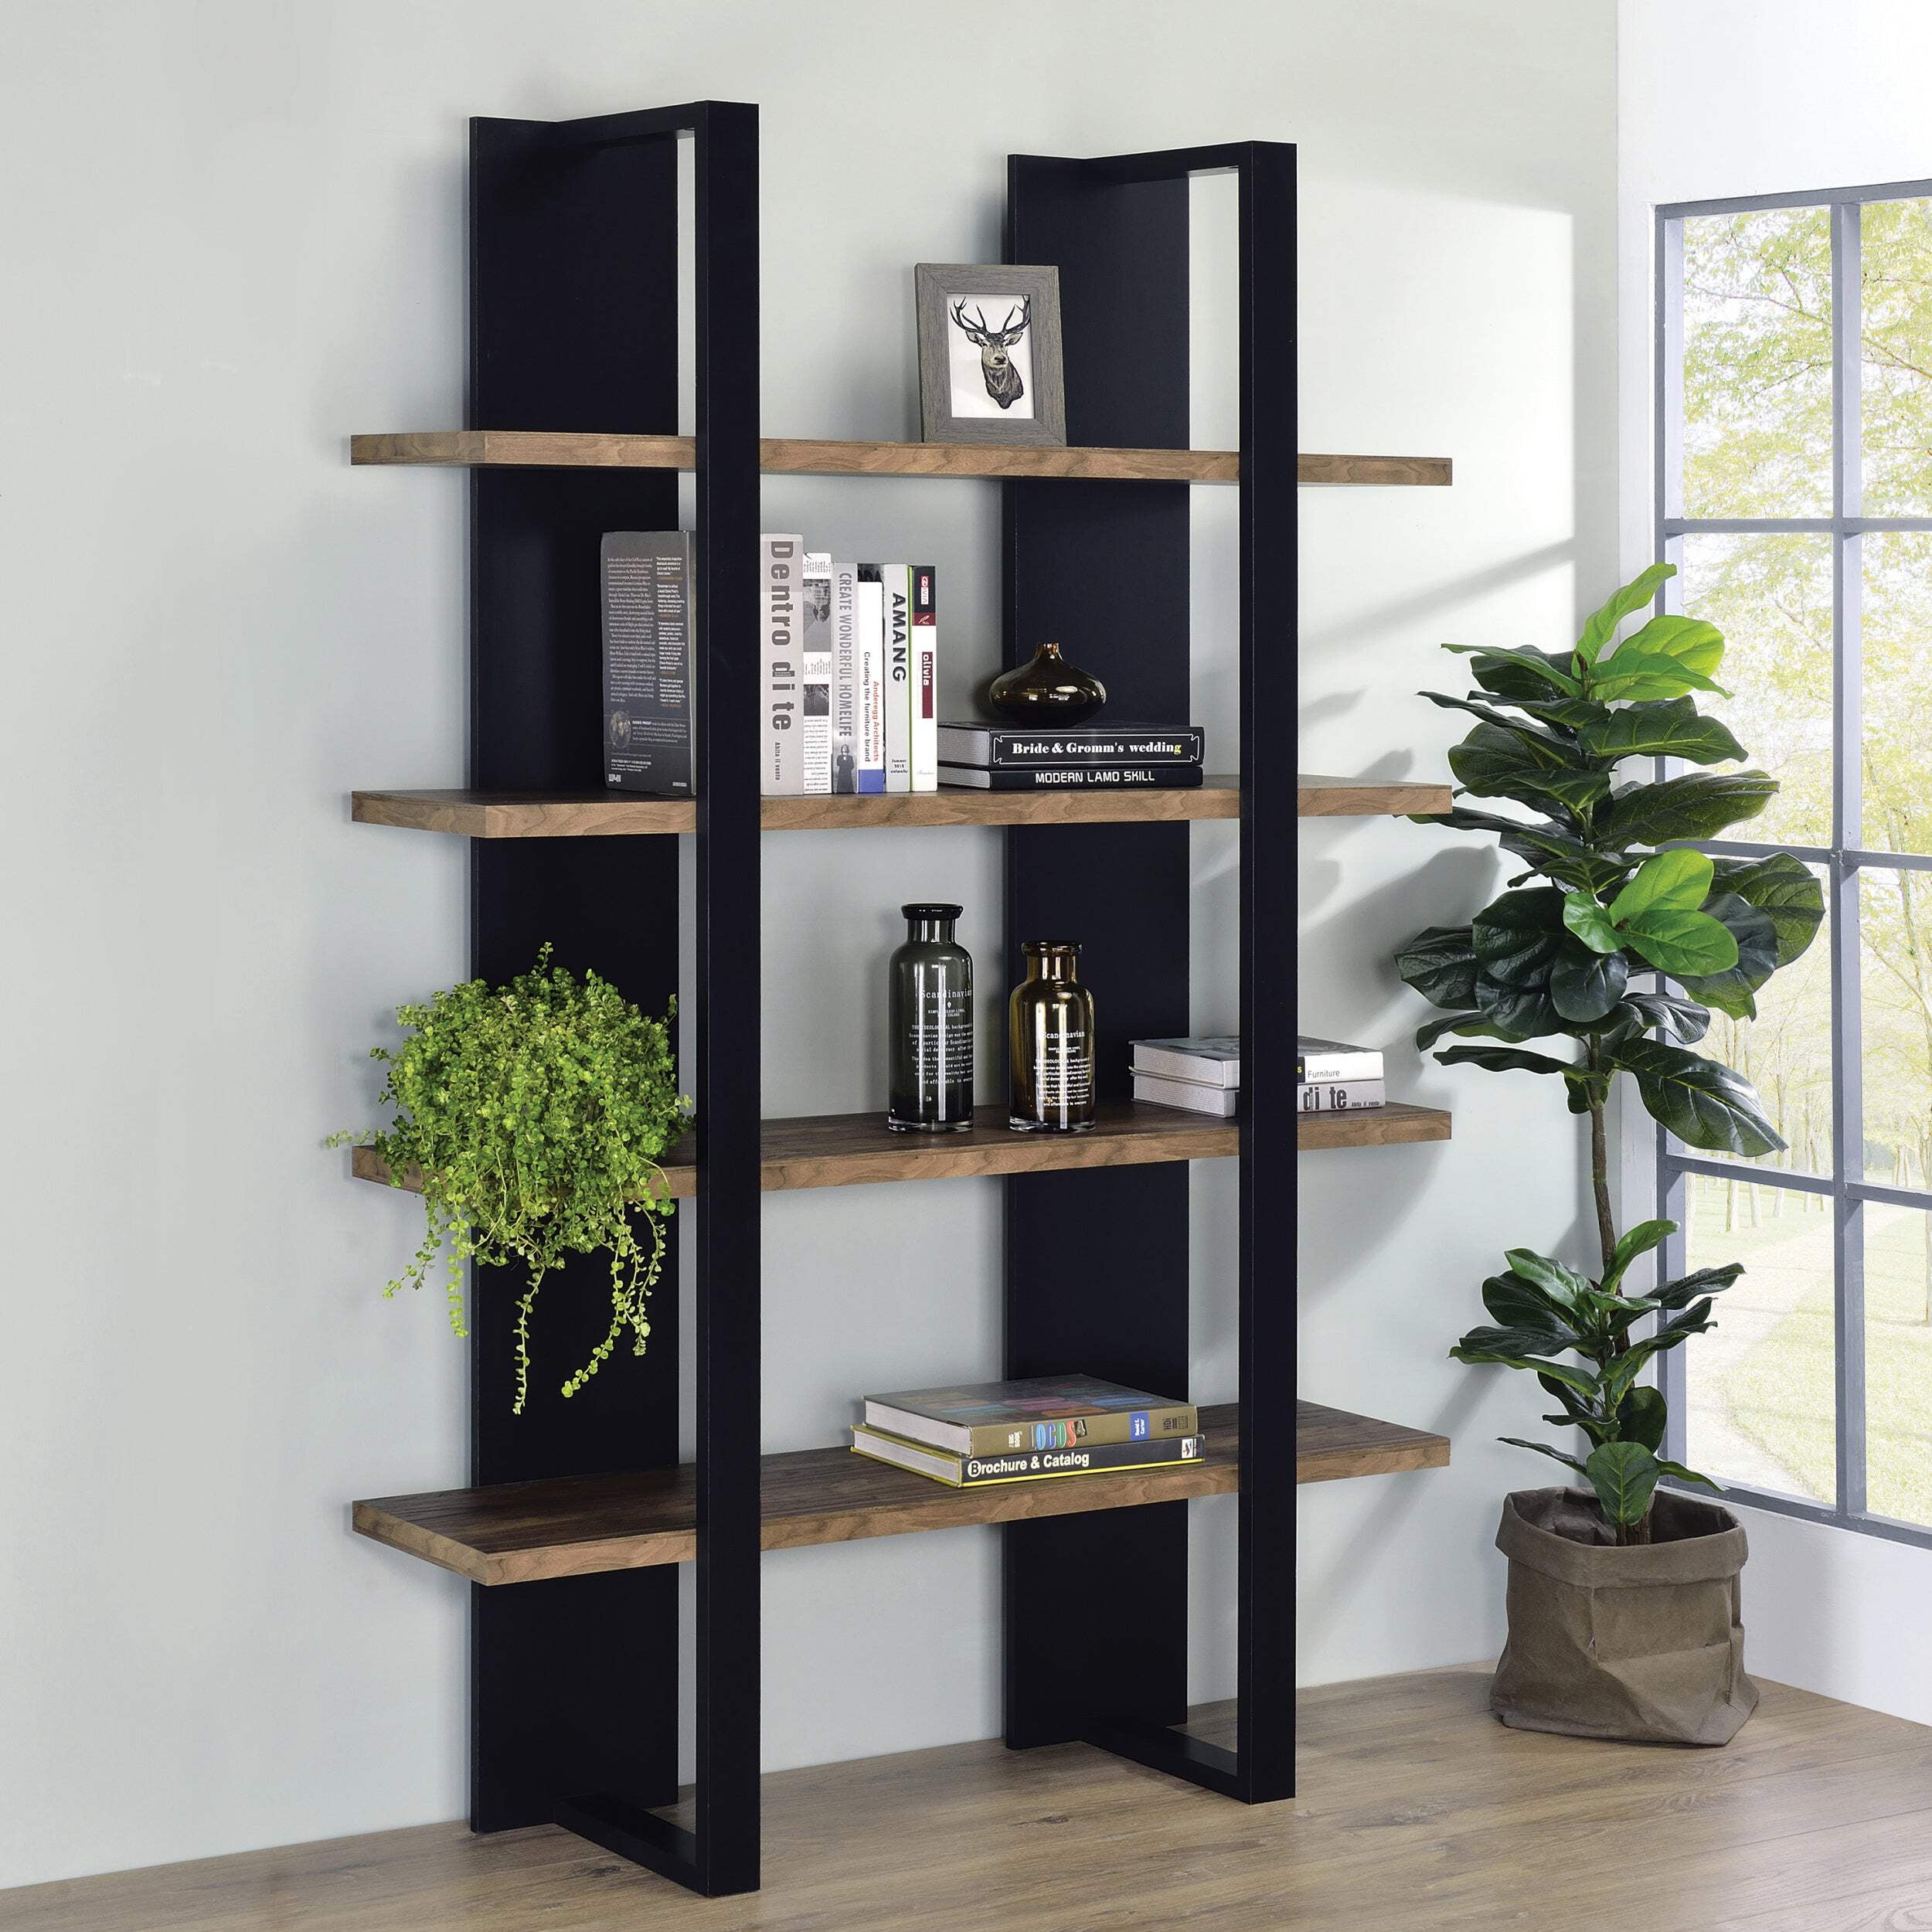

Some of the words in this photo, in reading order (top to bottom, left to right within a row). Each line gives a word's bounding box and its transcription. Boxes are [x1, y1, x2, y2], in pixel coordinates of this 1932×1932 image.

[771, 541, 794, 646] Dentro
[839, 573, 852, 611] CREATE
[839, 614, 852, 680] WONDERFUL
[893, 593, 906, 682] AMANG
[772, 662, 795, 690] di
[923, 654, 932, 685] olivia
[772, 702, 794, 730] te
[839, 684, 852, 736] HOMELIFE
[1012, 743, 1049, 754] Bride
[1051, 743, 1064, 754] &
[1066, 742, 1124, 753] Gromm's
[1129, 741, 1182, 755] wedding
[1036, 772, 1083, 784] MODERN
[1087, 771, 1120, 782] LAMO
[1124, 770, 1155, 782] SKILL
[1043, 1029, 1085, 1039] Scannavian
[1308, 1070, 1340, 1078] Furniture
[1303, 1087, 1320, 1111] di
[1329, 1086, 1347, 1109] te
[968, 1458, 1028, 1478] Brochure
[1030, 1456, 1040, 1469] &
[1043, 1452, 1090, 1468] Catalog
